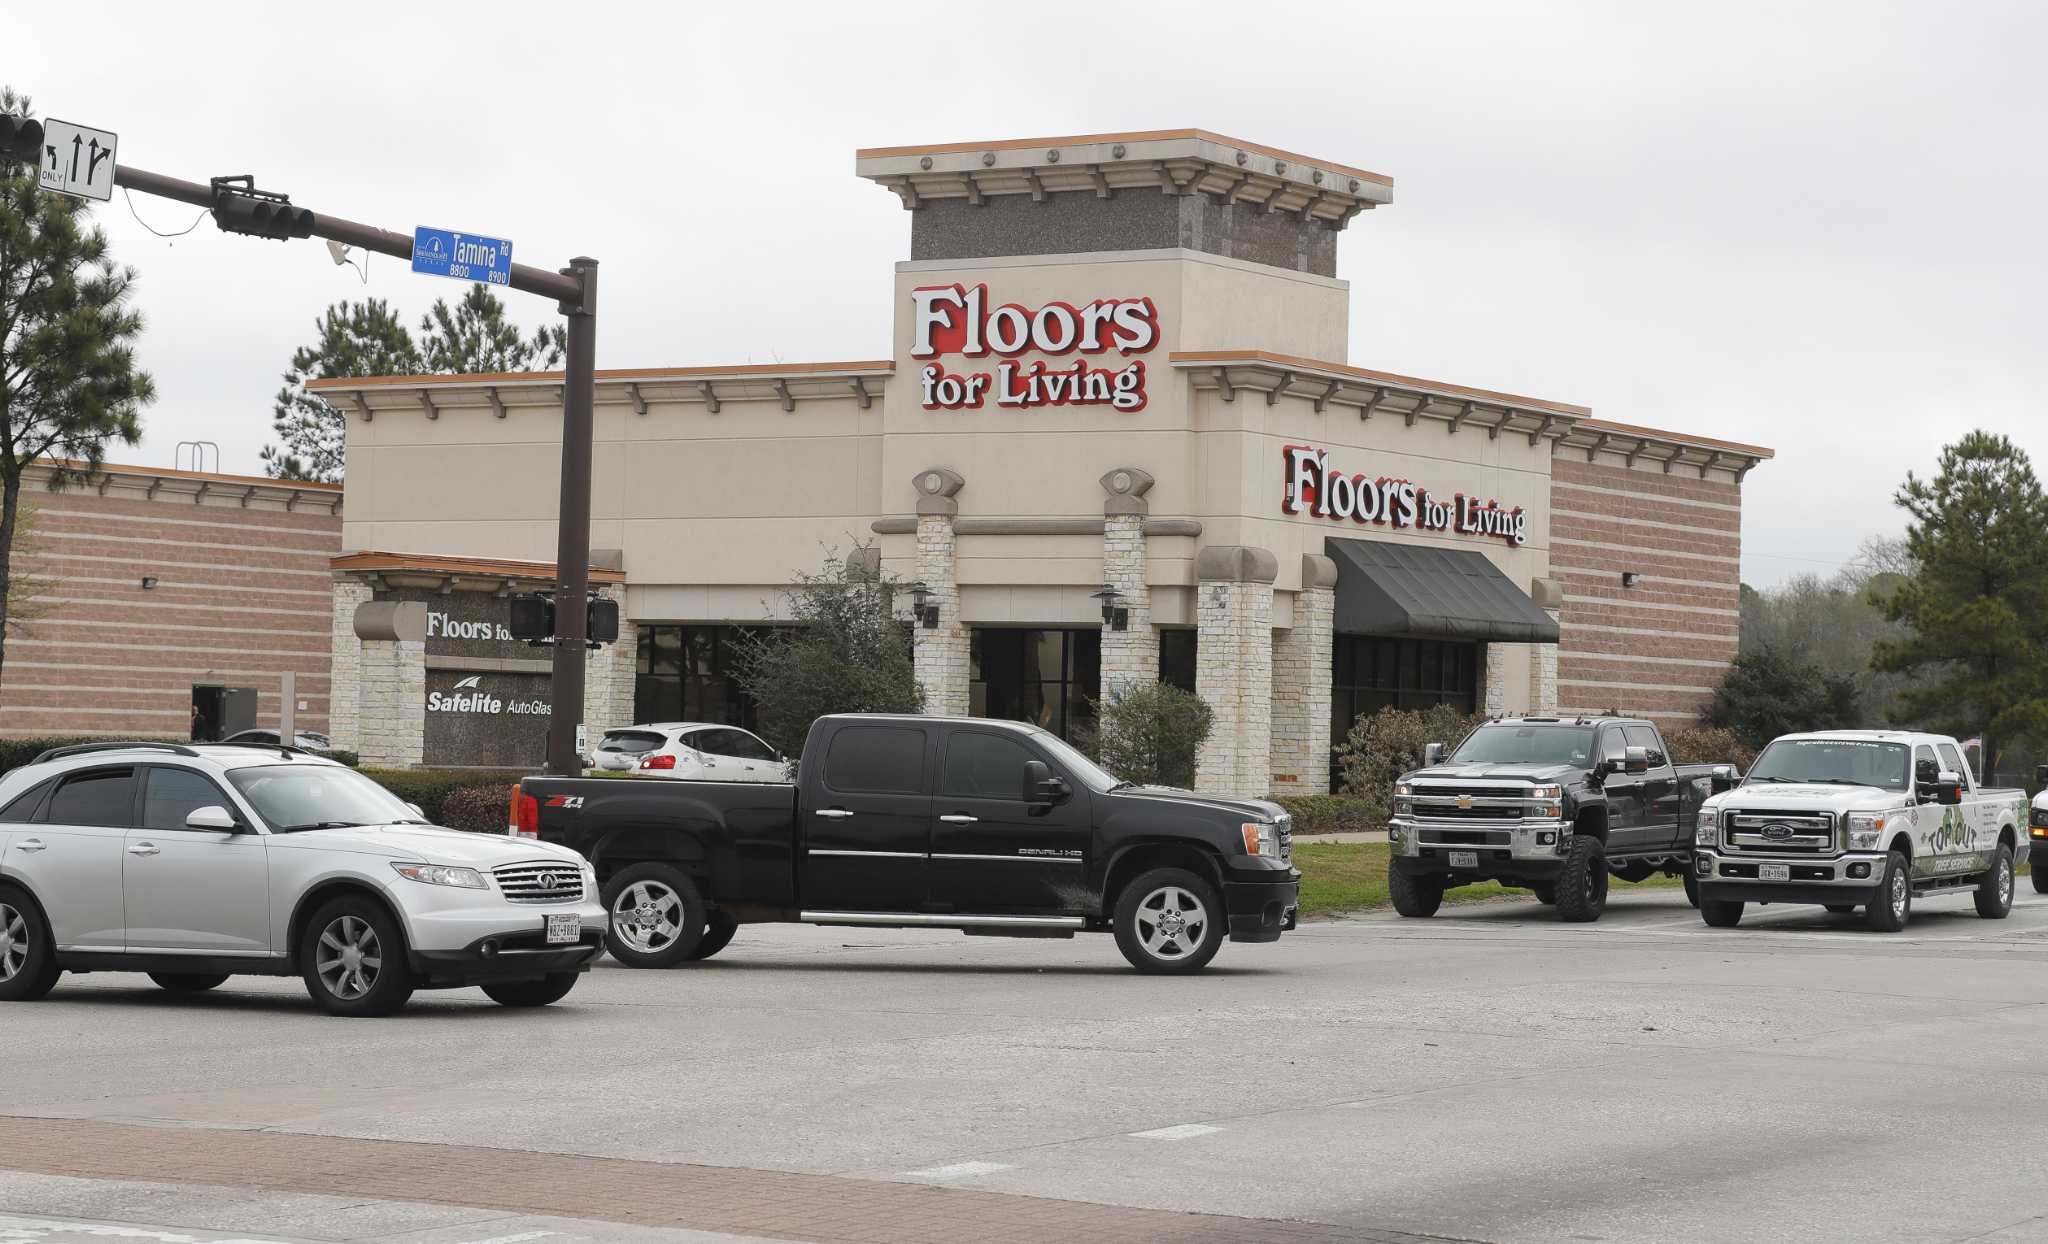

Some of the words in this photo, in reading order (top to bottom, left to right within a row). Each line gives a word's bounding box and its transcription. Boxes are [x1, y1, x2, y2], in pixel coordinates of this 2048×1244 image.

[42, 170, 63, 182] ONLY
[453, 233, 496, 268] Tamina
[500, 241, 509, 256] Rd
[449, 263, 470, 278] 8800
[488, 270, 507, 284] 8900
[910, 285, 1157, 356] Floors
[920, 365, 987, 406] for
[998, 361, 1143, 409] Living
[1286, 447, 1418, 527] Floors
[1424, 490, 1455, 529] for
[1462, 495, 1528, 545] Living
[427, 612, 493, 640] Floors
[427, 691, 502, 714] Safelite
[506, 700, 552, 716] AutoGlas
[1018, 848, 1063, 856] DENALI
